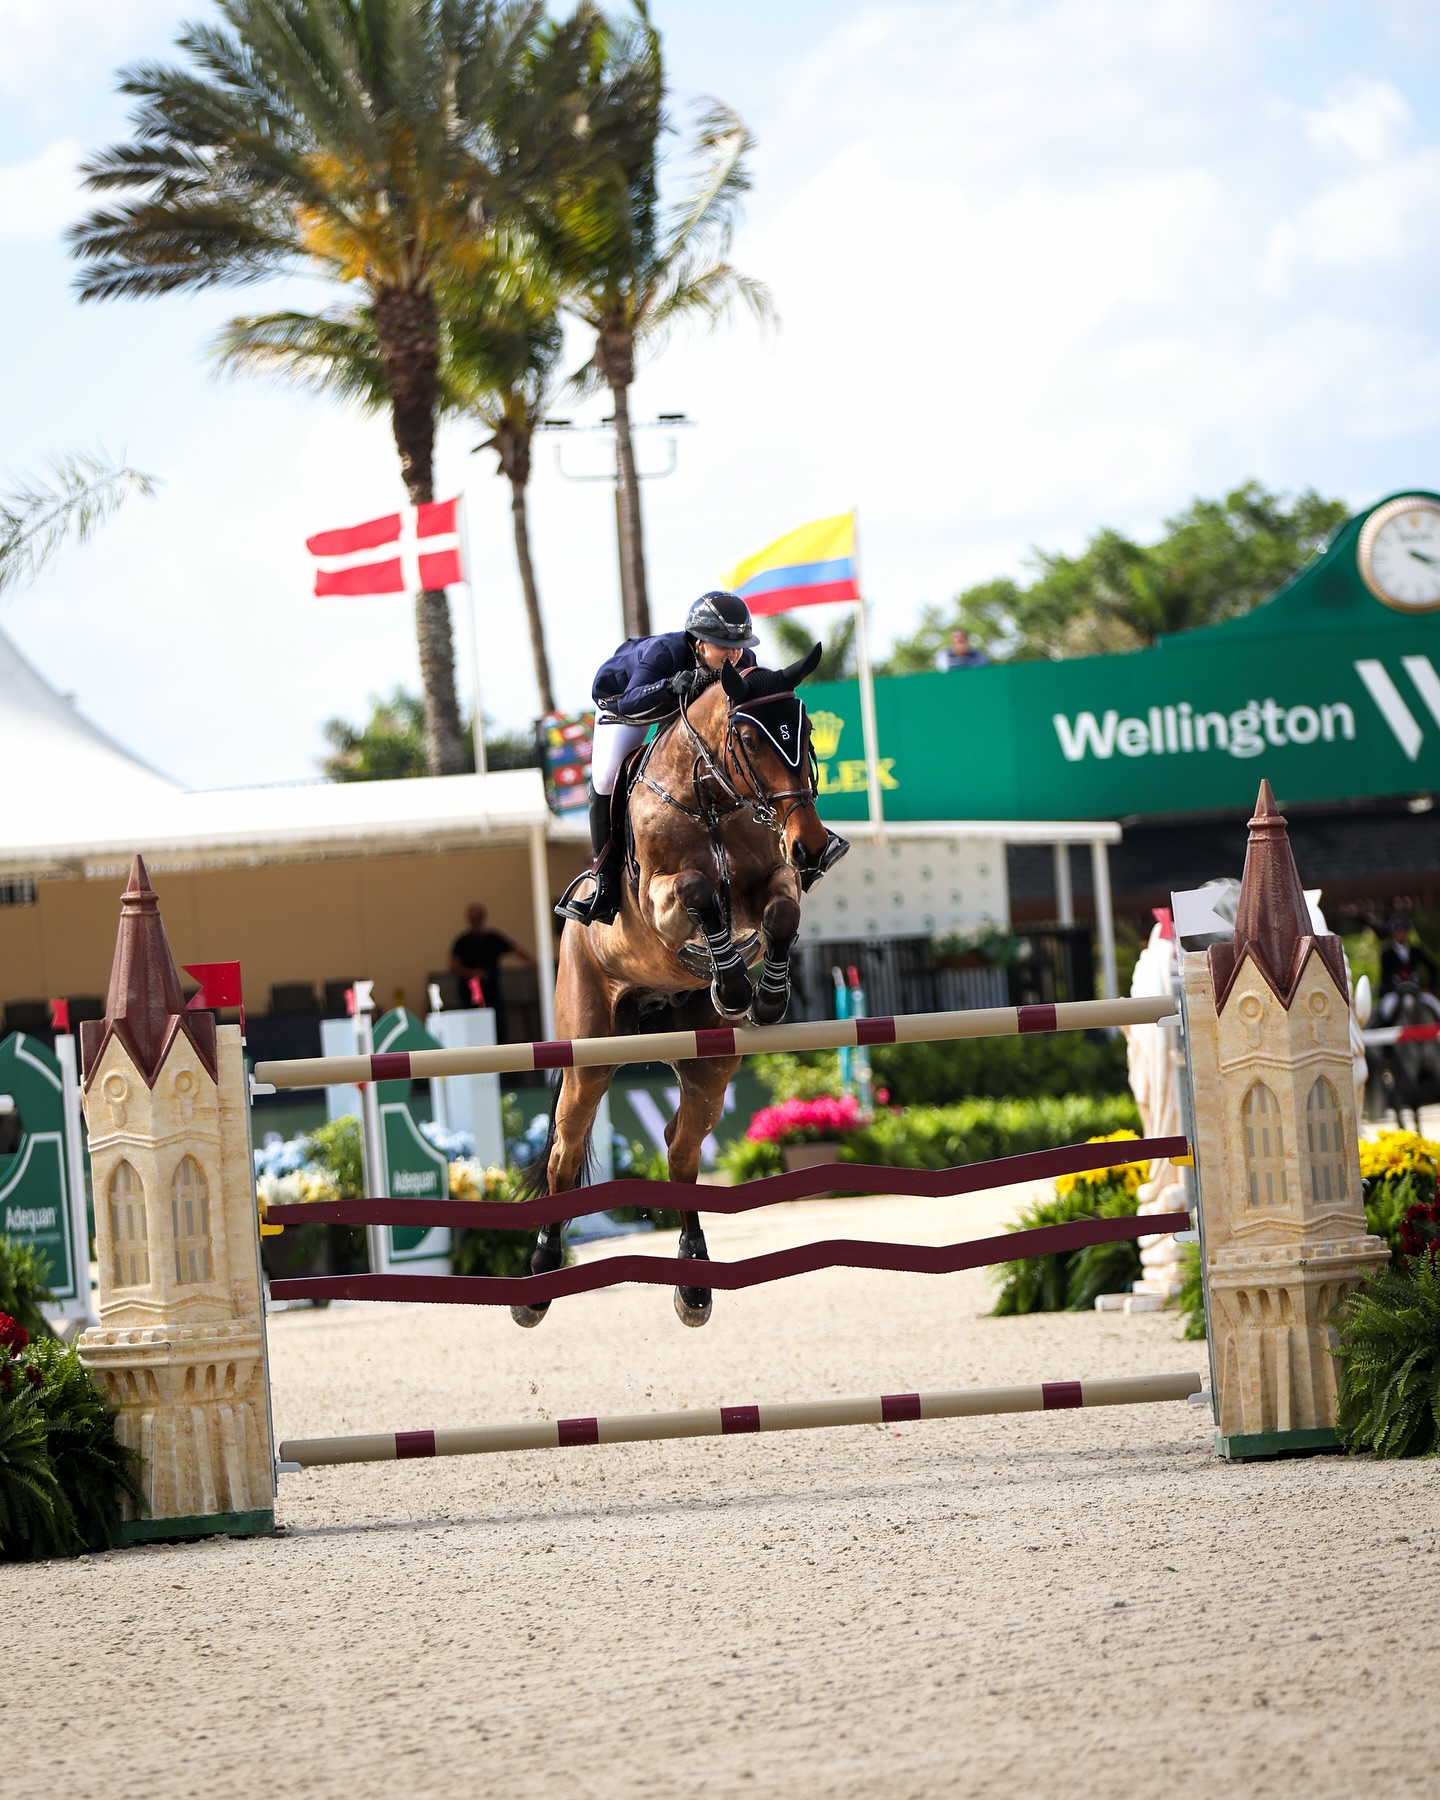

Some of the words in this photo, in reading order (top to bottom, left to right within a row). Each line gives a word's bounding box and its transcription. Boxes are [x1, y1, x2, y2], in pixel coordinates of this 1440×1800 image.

[1053, 699, 1356, 762] Wellington
[807, 758, 900, 795] LEX
[5, 1205, 57, 1235] Adequan
